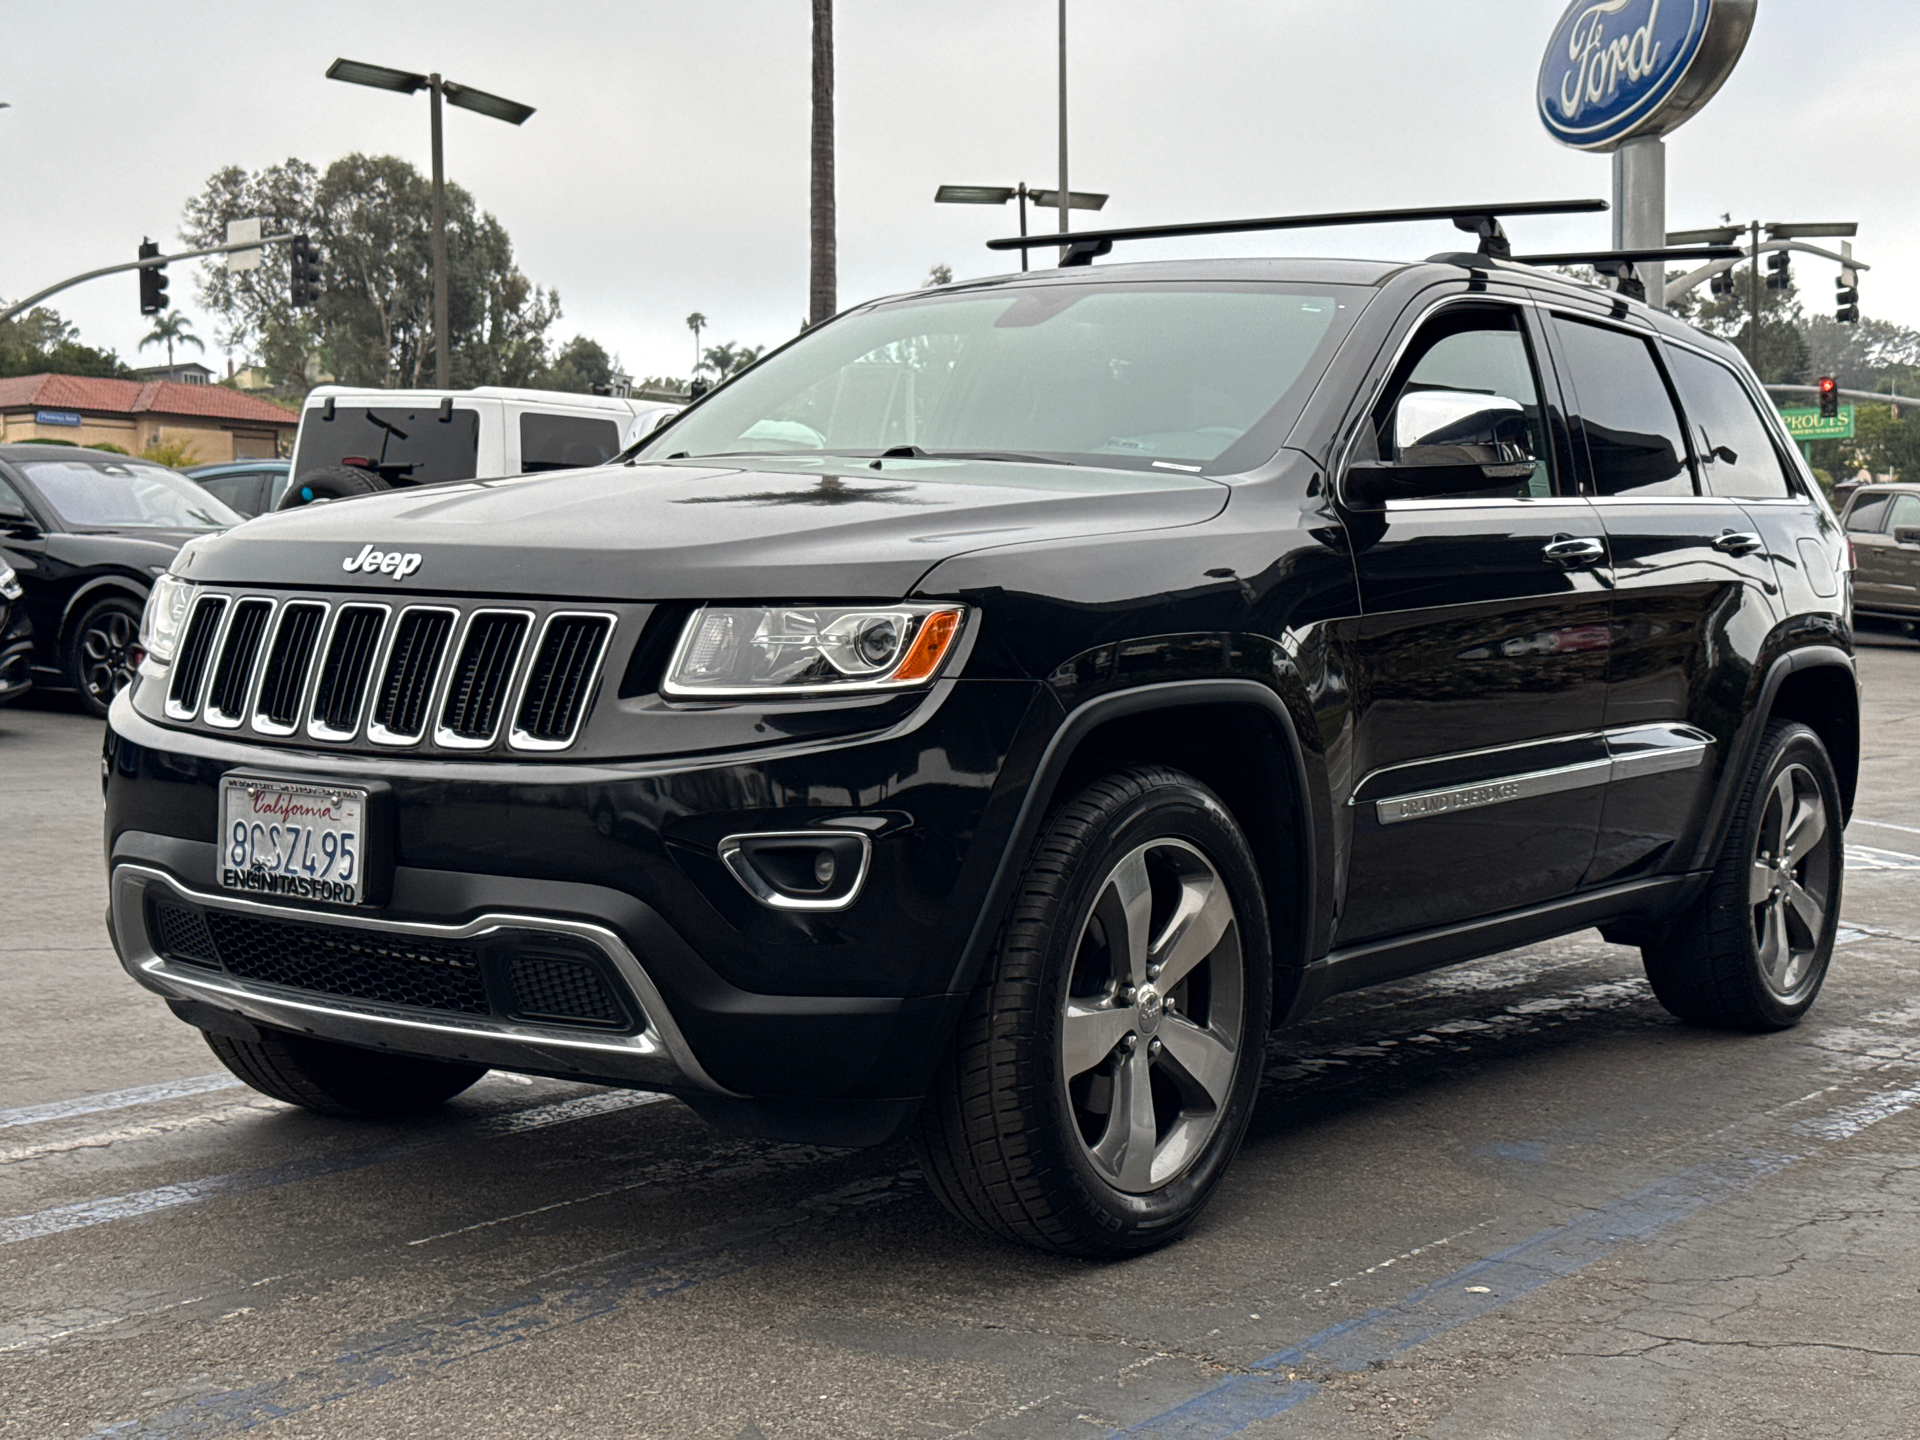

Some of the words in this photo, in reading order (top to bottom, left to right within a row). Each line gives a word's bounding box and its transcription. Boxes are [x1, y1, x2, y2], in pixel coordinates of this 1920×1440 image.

[1561, 0, 1661, 119] Ford
[1782, 412, 1849, 429] PROUTS
[343, 544, 422, 581] Jeep
[253, 790, 340, 823] California
[1400, 796, 1449, 818] GRAND
[1453, 783, 1519, 809] CHEROKEE
[231, 821, 355, 882] 8CSZ495
[311, 879, 355, 904] FORD
